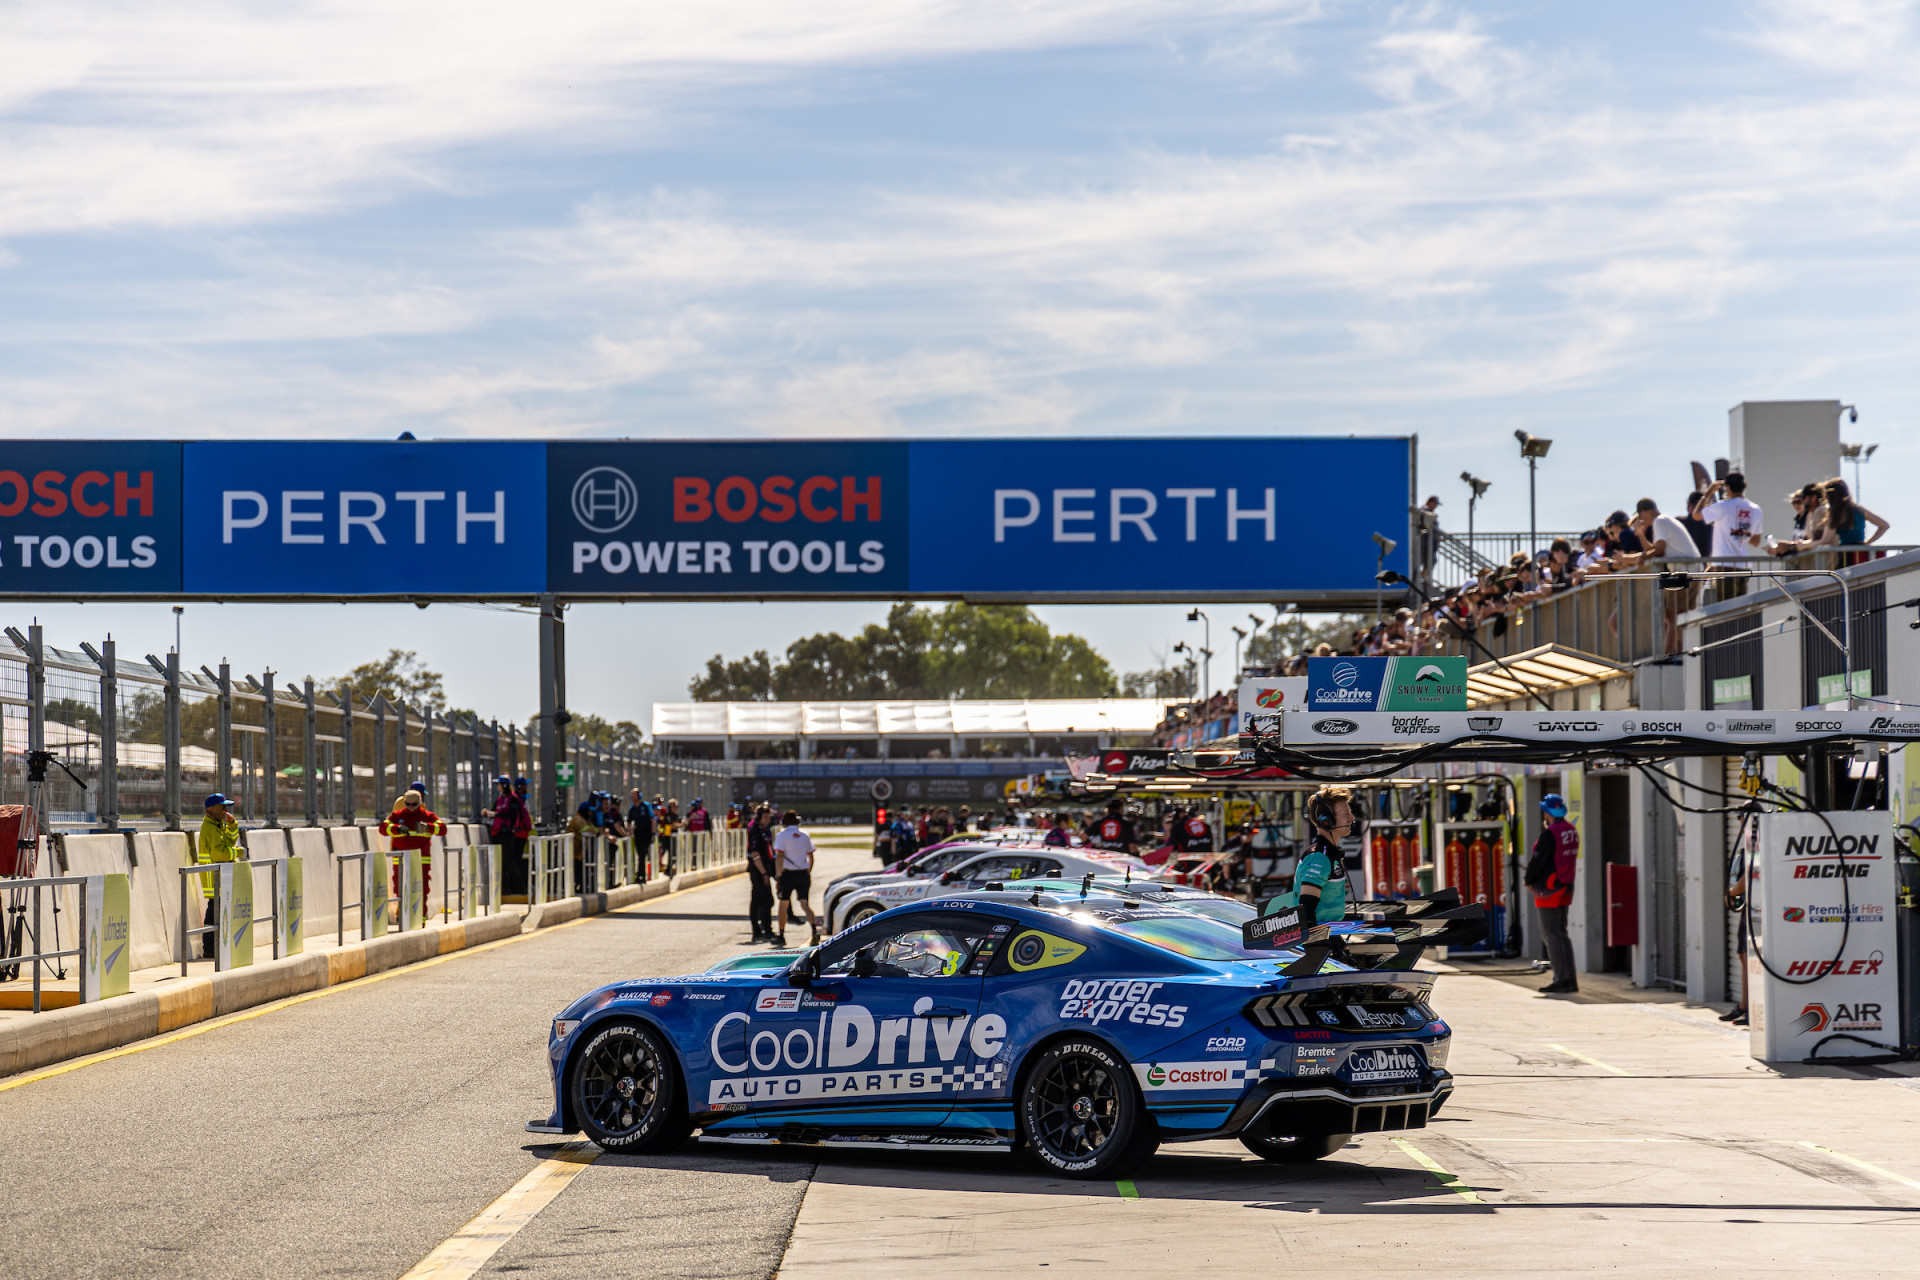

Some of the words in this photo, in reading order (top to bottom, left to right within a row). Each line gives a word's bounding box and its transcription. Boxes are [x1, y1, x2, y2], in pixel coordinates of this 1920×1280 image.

[0, 470, 154, 517] OSCH
[673, 475, 882, 523] BOSCH
[222, 490, 506, 544] PERTH
[993, 487, 1276, 543] PERTH
[14, 535, 157, 568] TOOLS
[573, 540, 732, 573] POWER
[742, 539, 885, 573] TOOLS
[1315, 687, 1373, 699] CoolDrive
[1397, 684, 1429, 695] SNOWY
[1436, 684, 1463, 695] RIVER
[1321, 720, 1350, 733] Ford
[1391, 716, 1430, 727] border
[1538, 721, 1600, 732] DAYCO
[1641, 722, 1682, 732] BOSCH
[1728, 721, 1773, 732] ultimate
[1795, 720, 1842, 732] sparco
[1393, 725, 1441, 736] express
[1129, 755, 1165, 770] Pizza
[1785, 834, 1880, 855] NULON
[1011, 868, 1022, 880] 12
[1793, 863, 1870, 879] RACING
[943, 901, 975, 909] LOVE
[1250, 910, 1300, 938] CalOffroad
[942, 951, 959, 976] 3
[1786, 959, 1883, 976] HIFLEX
[618, 991, 653, 999] SAKURA
[688, 993, 726, 1001] DUNLOP
[1060, 979, 1163, 1002] border
[1060, 1000, 1189, 1027] express
[1346, 1005, 1406, 1027] Aerpro
[1832, 1003, 1882, 1022] AIR
[585, 1030, 610, 1057] SPORT
[610, 1026, 637, 1037] MAXX
[710, 996, 1008, 1073] CoolDrive
[1207, 1037, 1247, 1047] FORD
[1295, 1031, 1331, 1039] LOCTITE
[1062, 1044, 1115, 1067] DUNLOP
[1297, 1046, 1336, 1057] Bremtec
[1348, 1048, 1416, 1071] CoolDrive
[1168, 1068, 1228, 1083] Castrol
[1298, 1065, 1331, 1075] Brakes
[718, 1078, 801, 1099] AUTO
[821, 1072, 925, 1093] PARTS
[601, 1120, 650, 1146] DUNLOP
[1038, 1147, 1066, 1169] MAXX
[1064, 1157, 1098, 1171] SPORT
